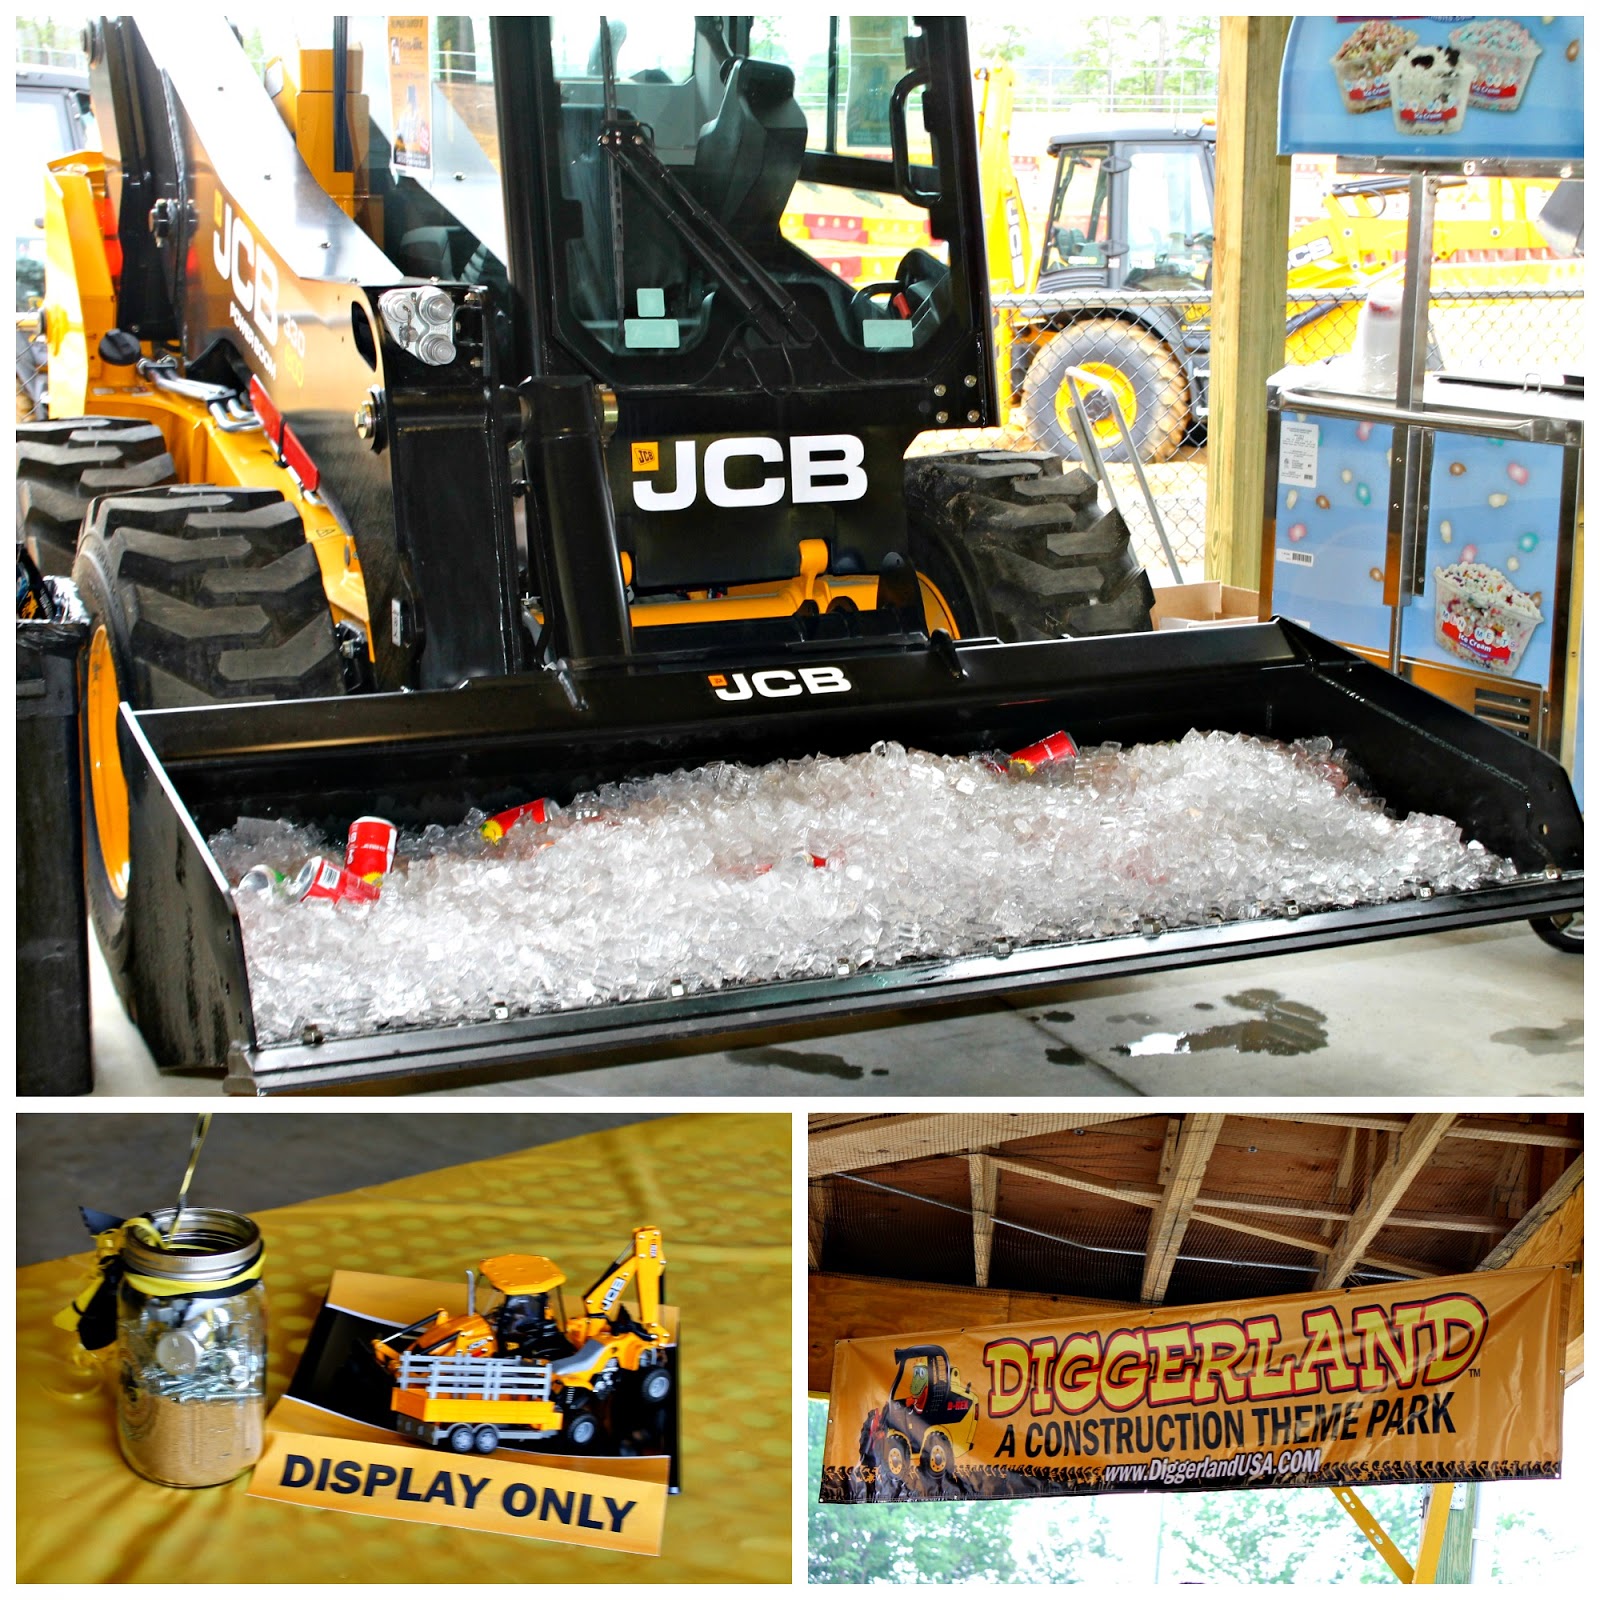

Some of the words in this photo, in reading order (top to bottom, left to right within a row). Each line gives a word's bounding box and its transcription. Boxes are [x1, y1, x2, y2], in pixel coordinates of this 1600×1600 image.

[213, 202, 279, 346] JCB
[1287, 236, 1333, 270] CB
[632, 434, 868, 512] JCB
[638, 450, 654, 463] JCB
[1458, 633, 1469, 643] Ice
[1469, 638, 1492, 652] Cream
[714, 666, 851, 701] JCB
[984, 1293, 1488, 1418] DIGGERLAND
[994, 1424, 1016, 1457] A
[1025, 1409, 1243, 1457] CONSTRUCTION
[1252, 1402, 1364, 1447] THEME
[1367, 1391, 1456, 1437] PARK
[1104, 1448, 1322, 1485] www.DiggerlandUSA.COM
[280, 1454, 491, 1509] DISPLAY
[502, 1483, 637, 1533] ONLY
